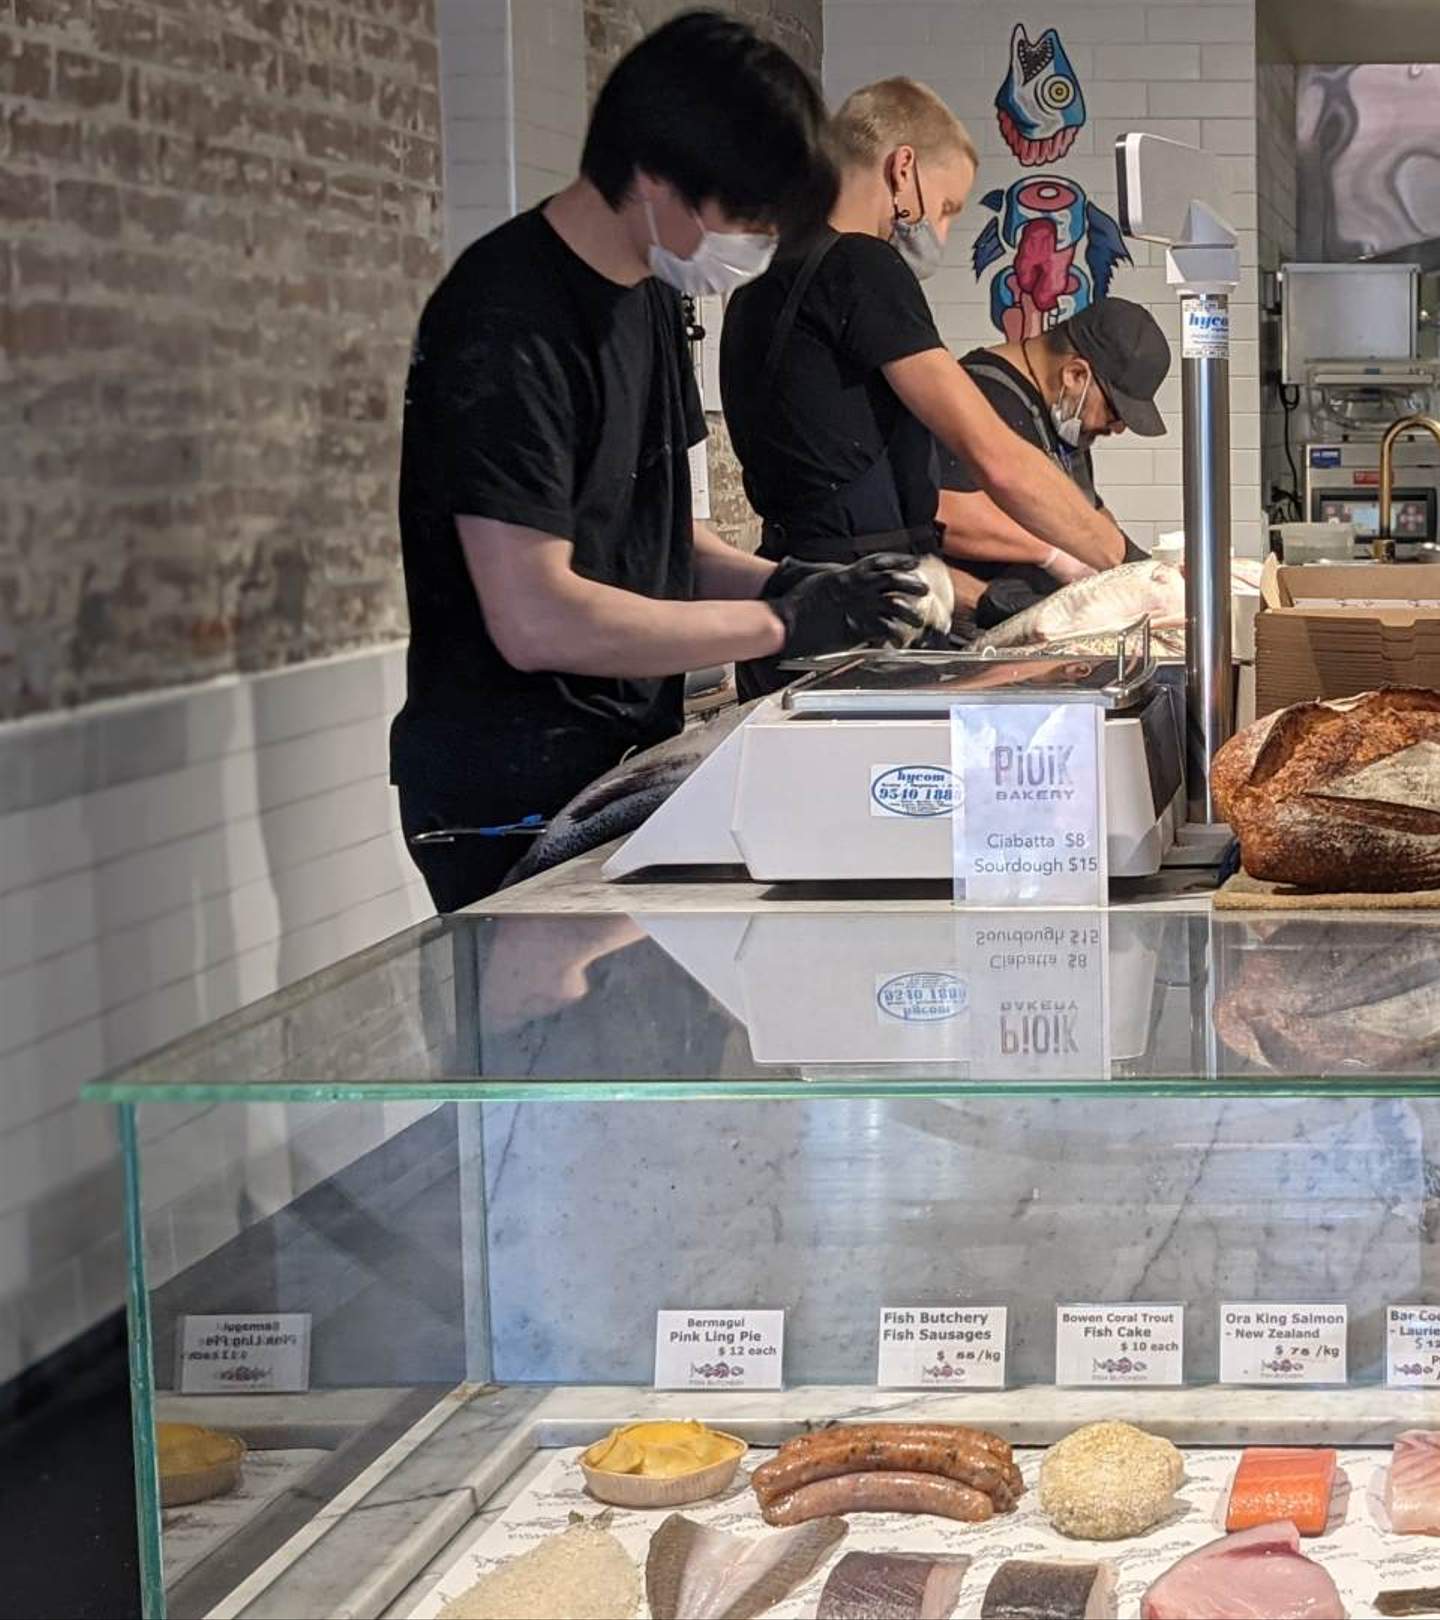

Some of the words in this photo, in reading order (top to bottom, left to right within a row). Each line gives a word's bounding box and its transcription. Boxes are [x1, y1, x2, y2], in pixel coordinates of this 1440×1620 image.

[897, 769, 945, 784] hycom
[996, 790, 1075, 801] BAKERY
[987, 833, 1055, 849] Ciabatta
[1065, 833, 1086, 848] $8
[974, 857, 1063, 876] Sourdough
[1068, 857, 1098, 873] $15
[884, 1312, 914, 1324] Fish
[920, 1312, 988, 1325] Butchery
[1063, 1313, 1103, 1323] Bowen
[1107, 1313, 1138, 1323] Coral
[1142, 1313, 1174, 1323] Trout
[1226, 1313, 1251, 1324] Ora
[1256, 1313, 1287, 1326] King
[1292, 1313, 1344, 1324] Salmon
[1391, 1311, 1415, 1321] Bar
[687, 1318, 745, 1329] Bermagui
[670, 1331, 701, 1342] Pink
[705, 1331, 735, 1344] Ling
[740, 1331, 761, 1342] Pie
[884, 1329, 914, 1340] Fish
[920, 1329, 991, 1342] Sausages
[1084, 1327, 1112, 1338] Fish
[1117, 1327, 1152, 1338] Cake
[1235, 1329, 1264, 1339] New
[1268, 1329, 1320, 1339] Zealand
[730, 1346, 744, 1356] 12
[748, 1346, 777, 1356] each
[1133, 1342, 1147, 1352] 10
[1150, 1342, 1179, 1352] each
